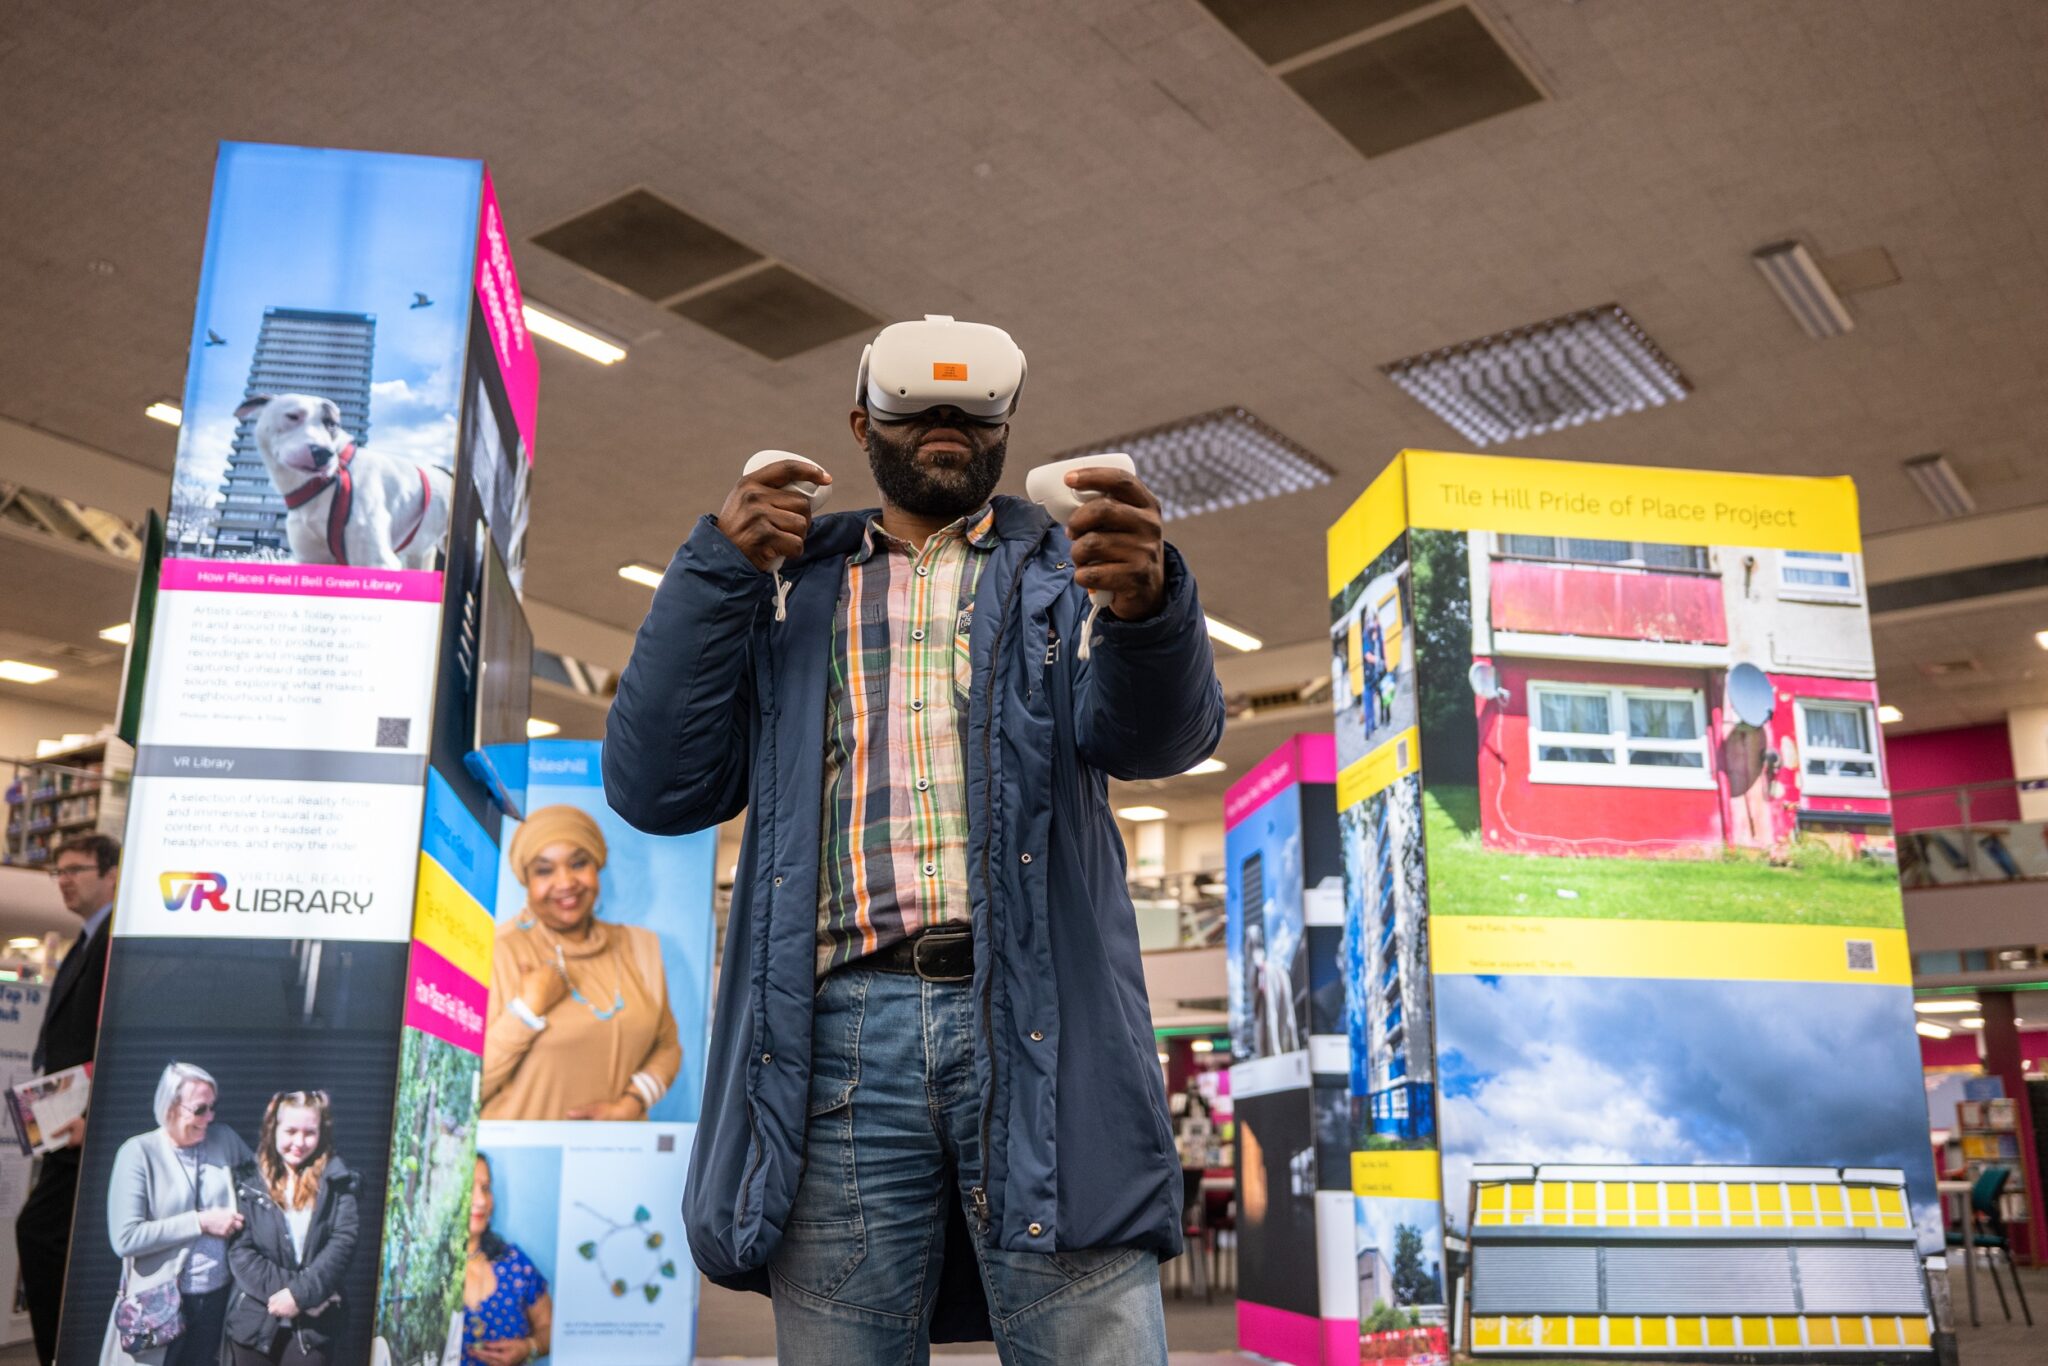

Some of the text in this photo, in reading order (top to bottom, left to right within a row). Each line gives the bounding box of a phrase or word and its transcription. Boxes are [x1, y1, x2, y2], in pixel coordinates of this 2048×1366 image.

[1440, 483, 1798, 530] Tile Hill Pride of Place Project
[197, 572, 224, 583] How
[227, 572, 265, 585] Places
[268, 574, 291, 586] Feel
[302, 576, 322, 588] Bell
[325, 577, 360, 590] Green
[362, 579, 403, 593] Library
[173, 756, 235, 772] VR Library
[238, 871, 374, 886] VIRTUAL REALITY
[158, 870, 231, 912] VR
[235, 887, 375, 915] LIBRARY
